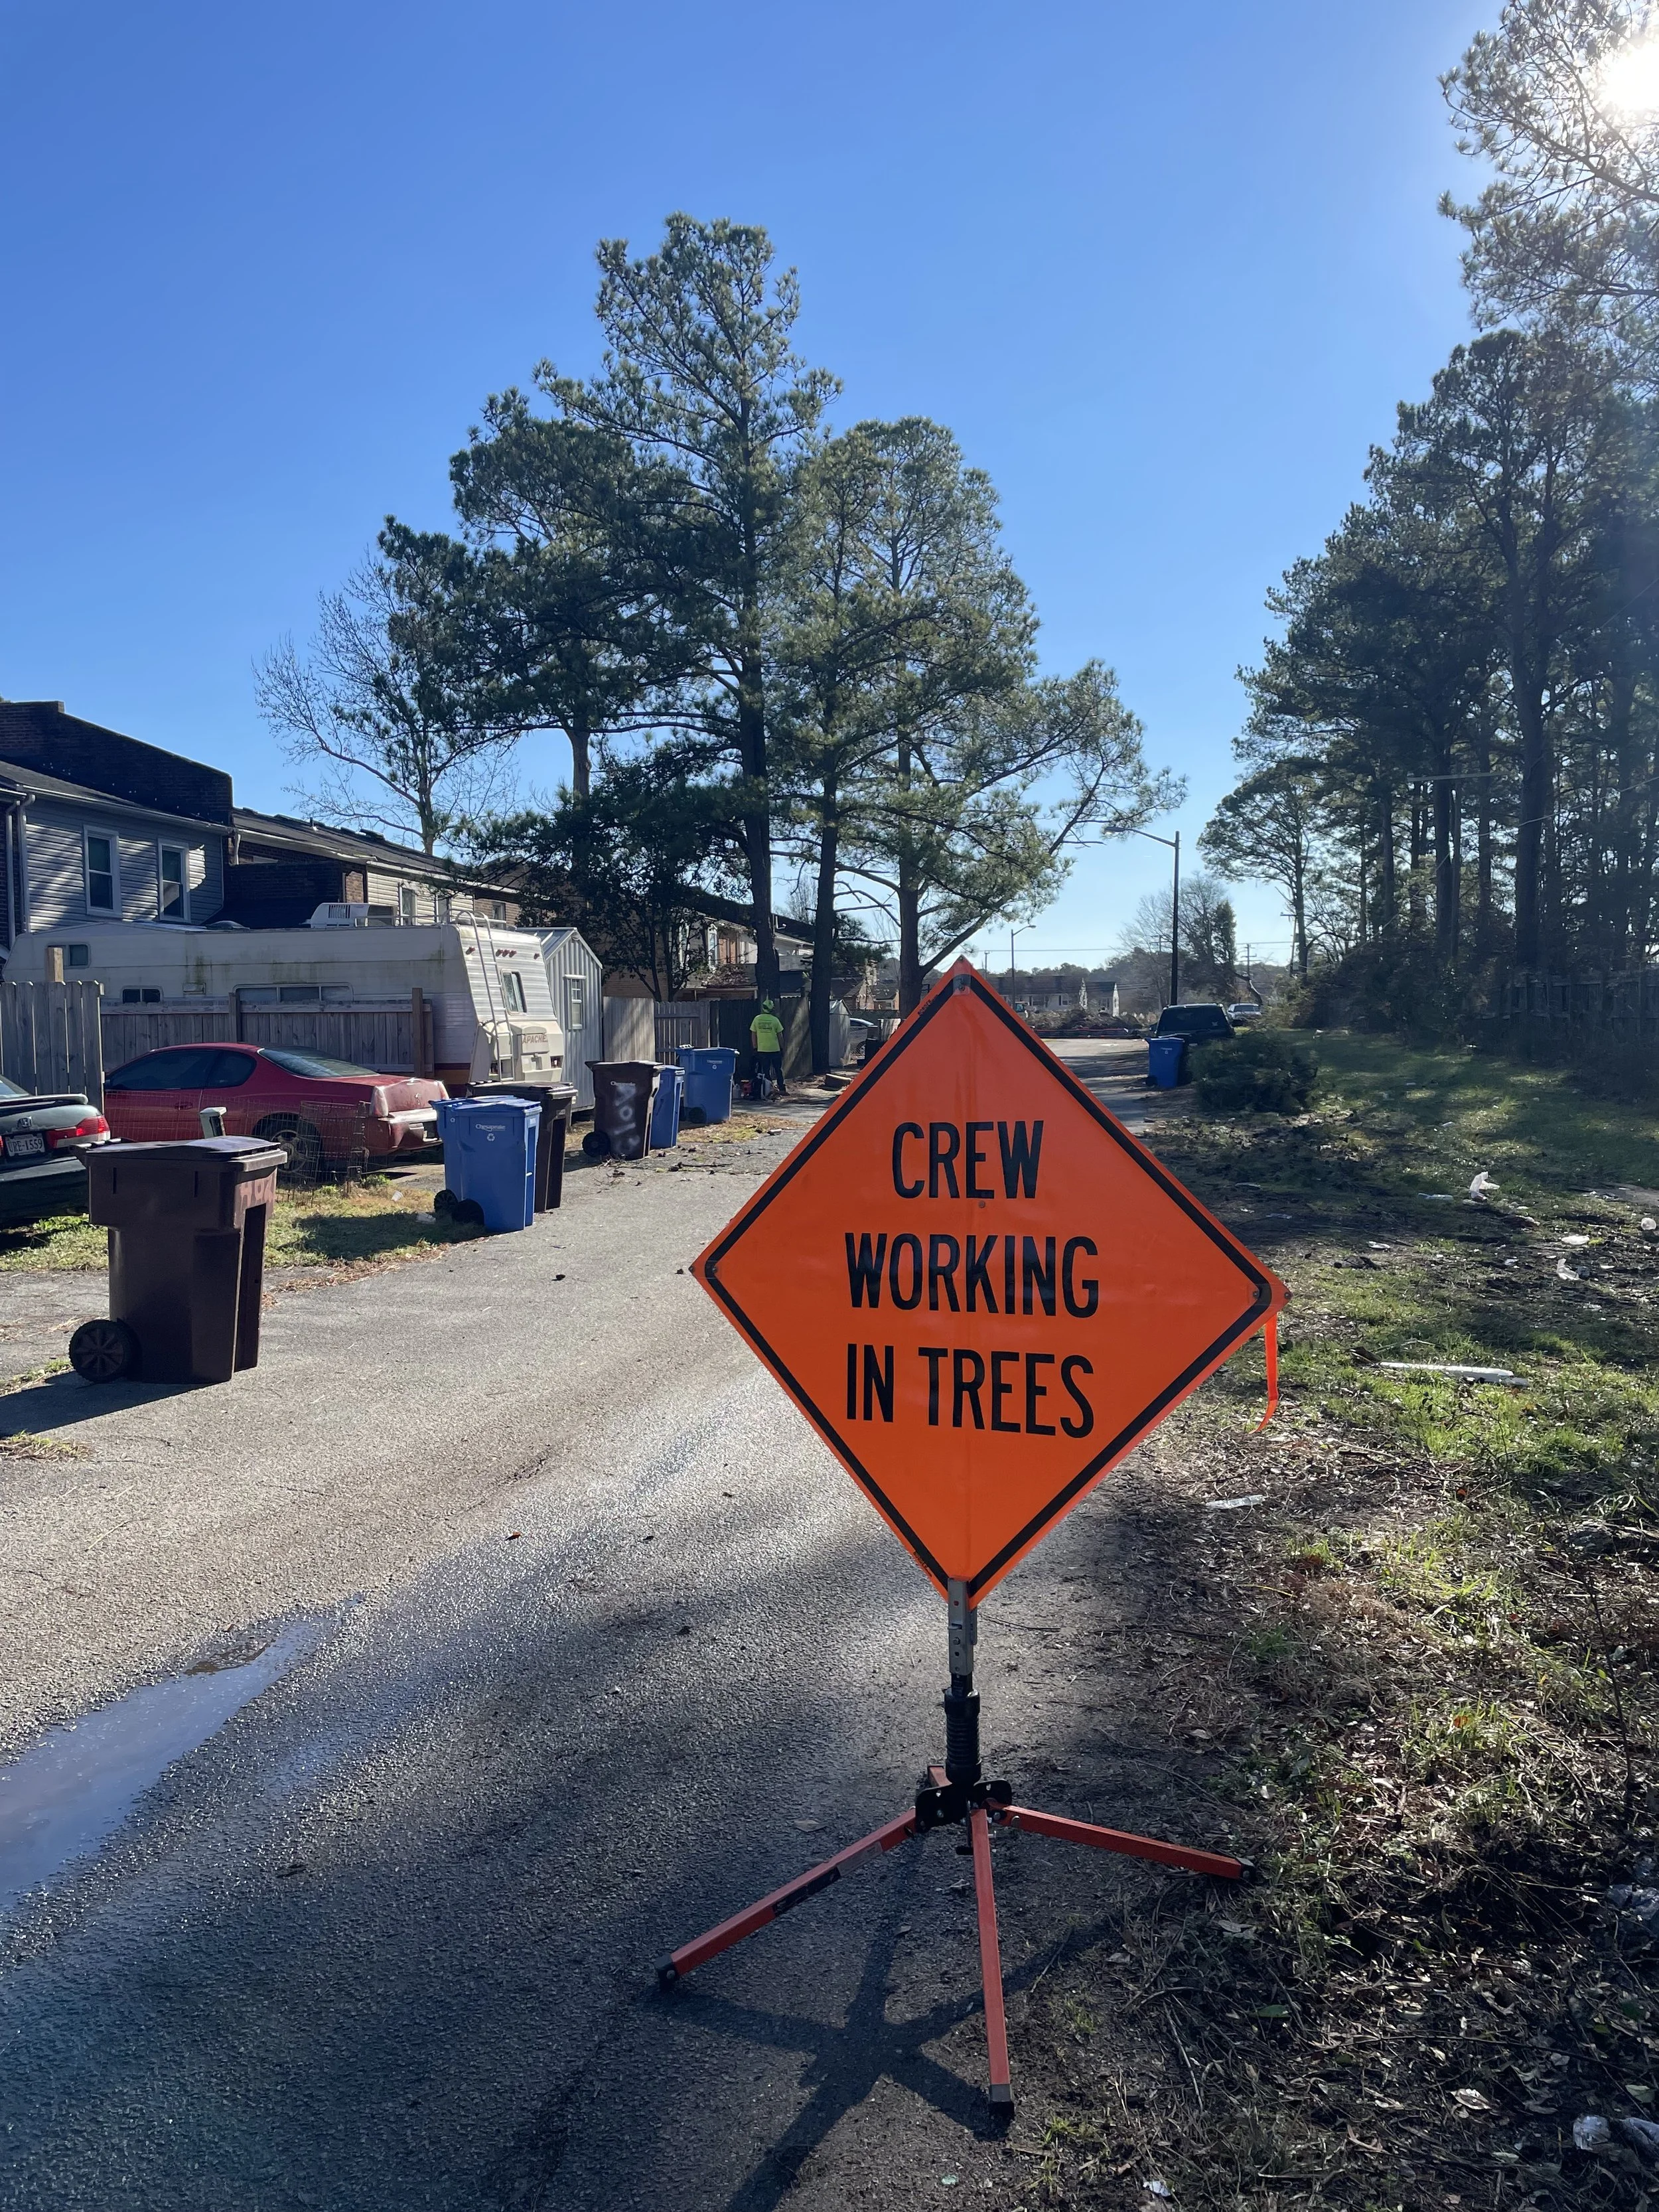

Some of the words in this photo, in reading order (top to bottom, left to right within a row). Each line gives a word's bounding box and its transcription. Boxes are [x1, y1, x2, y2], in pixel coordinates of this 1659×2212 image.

[522, 1035, 548, 1044] APACHE
[7, 1138, 42, 1153] URE-1559
[892, 1120, 1045, 1199] CREW
[845, 1232, 1099, 1319] WORKING
[847, 1343, 895, 1423] IN
[918, 1347, 1094, 1439] TREES
